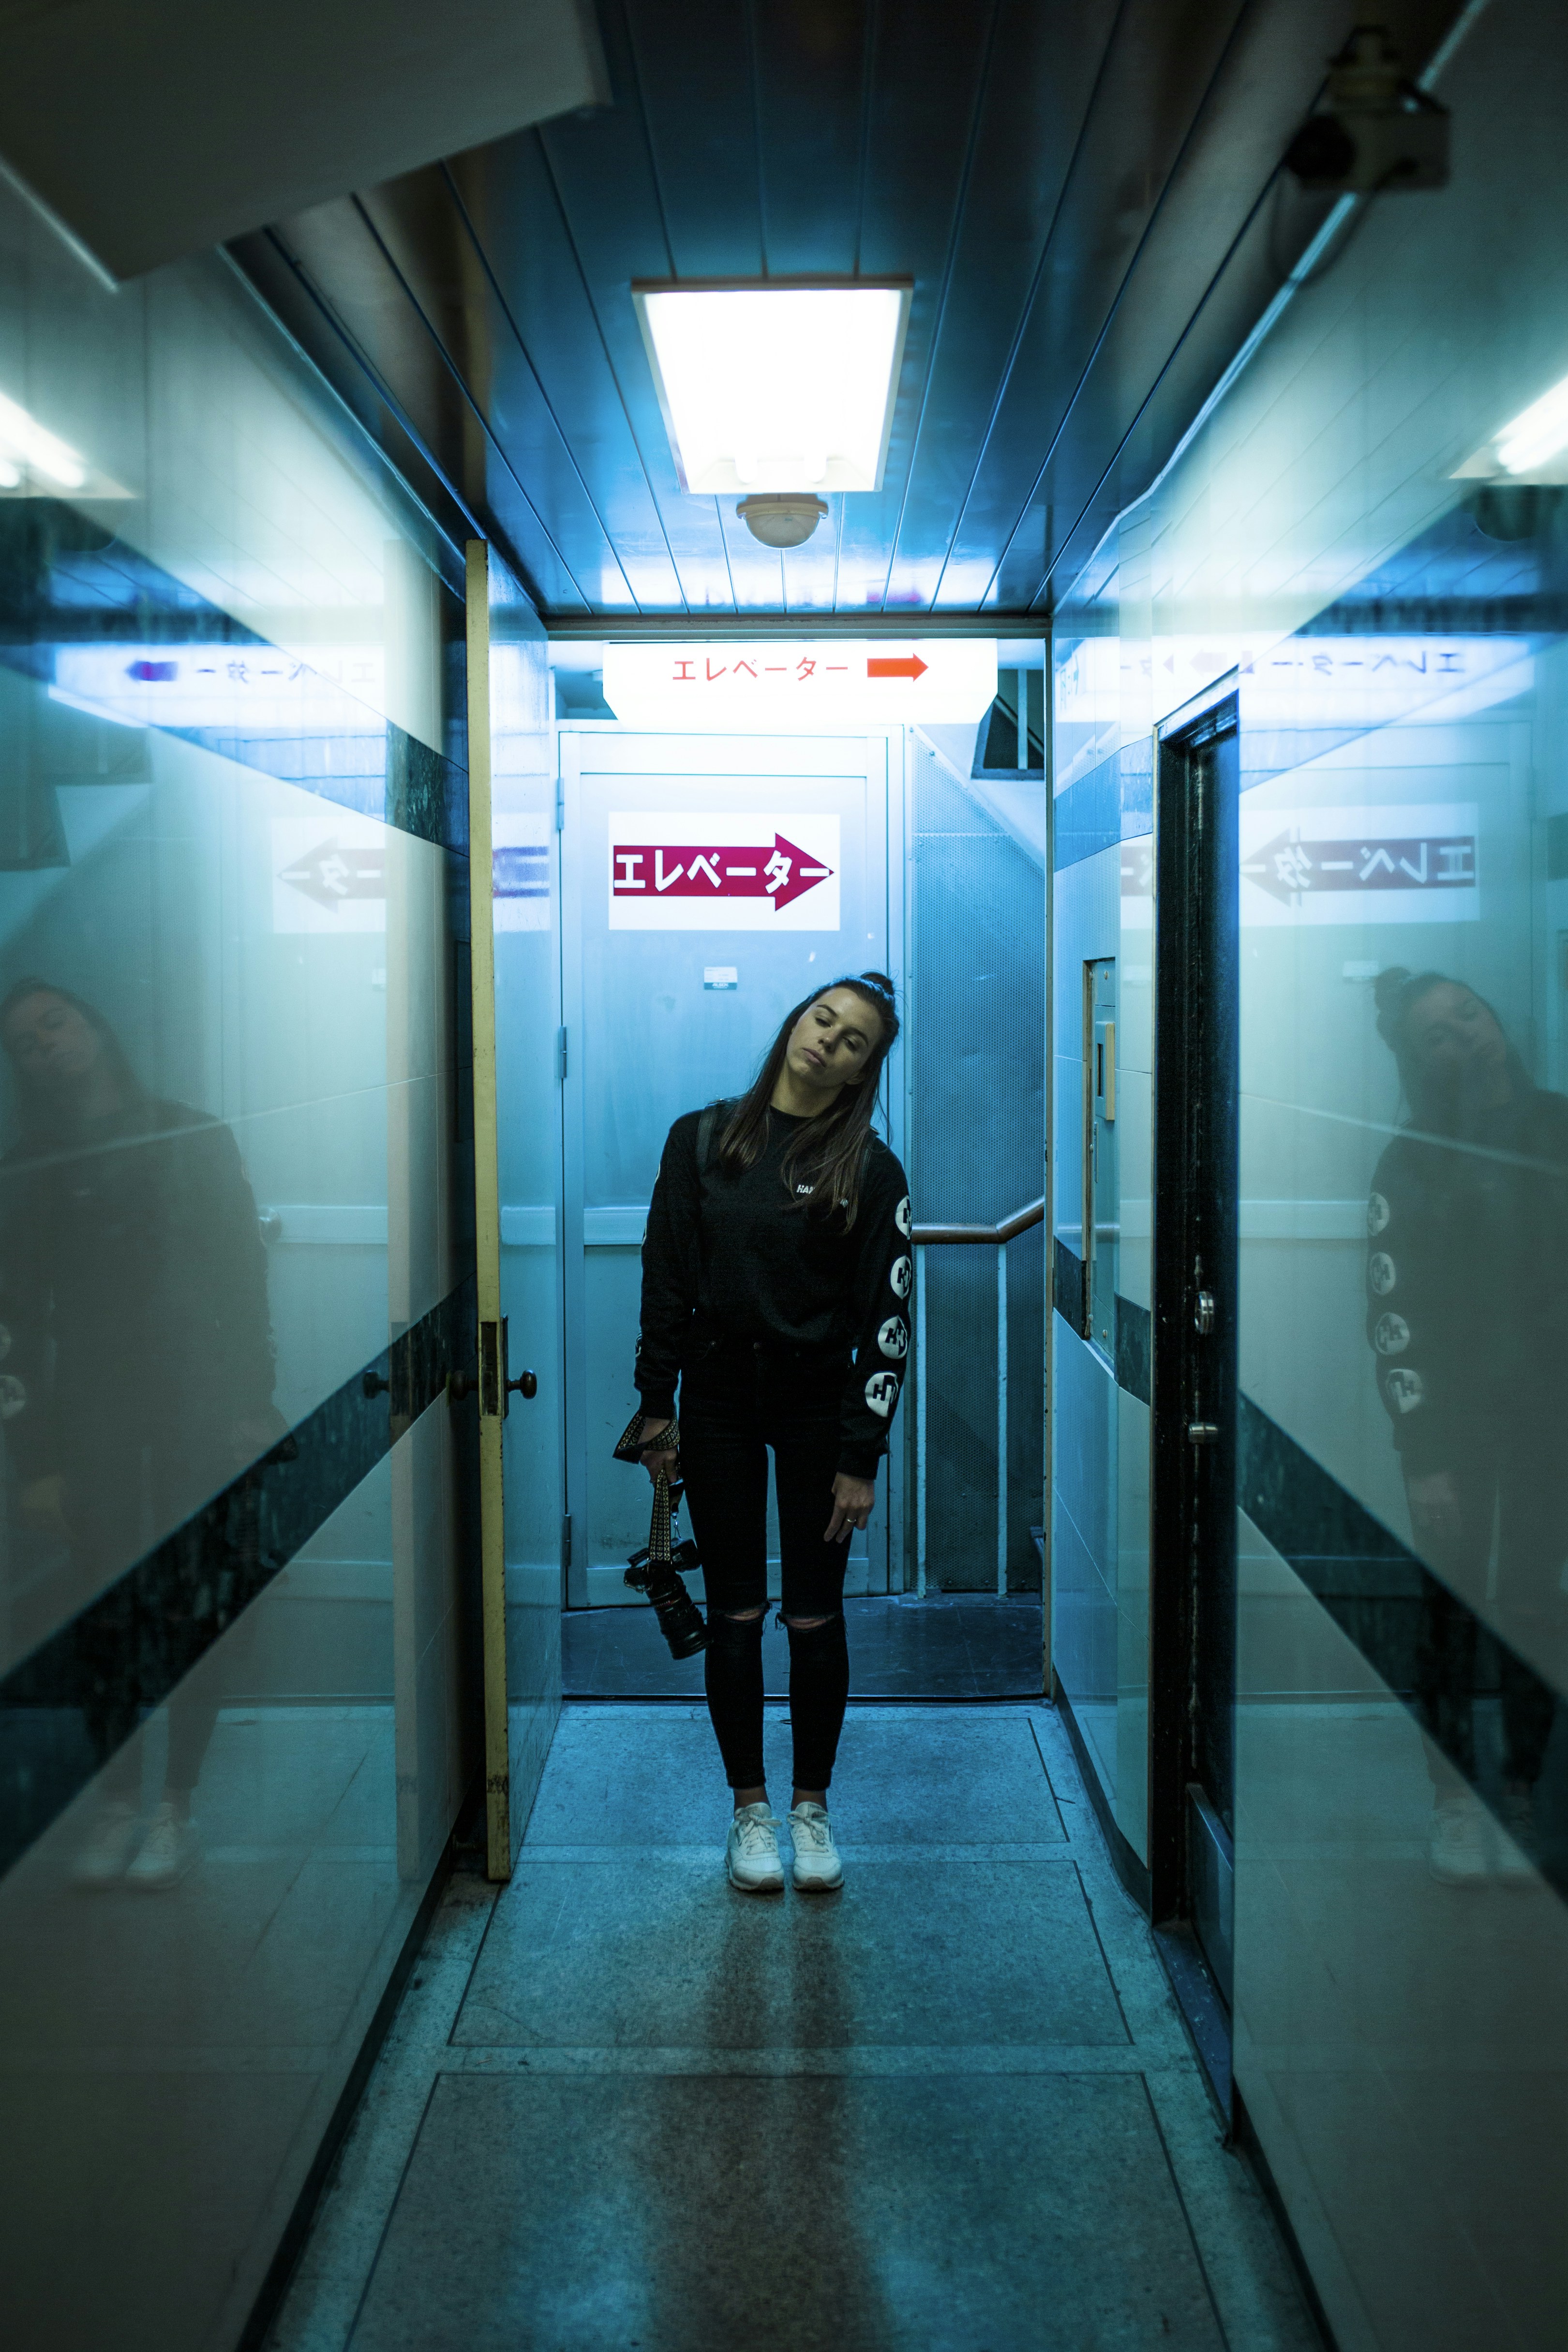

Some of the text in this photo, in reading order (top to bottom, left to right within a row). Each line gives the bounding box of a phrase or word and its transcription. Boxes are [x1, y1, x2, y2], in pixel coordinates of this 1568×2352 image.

[672, 656, 848, 681] エレベーター
[614, 849, 831, 893] エレベーター
